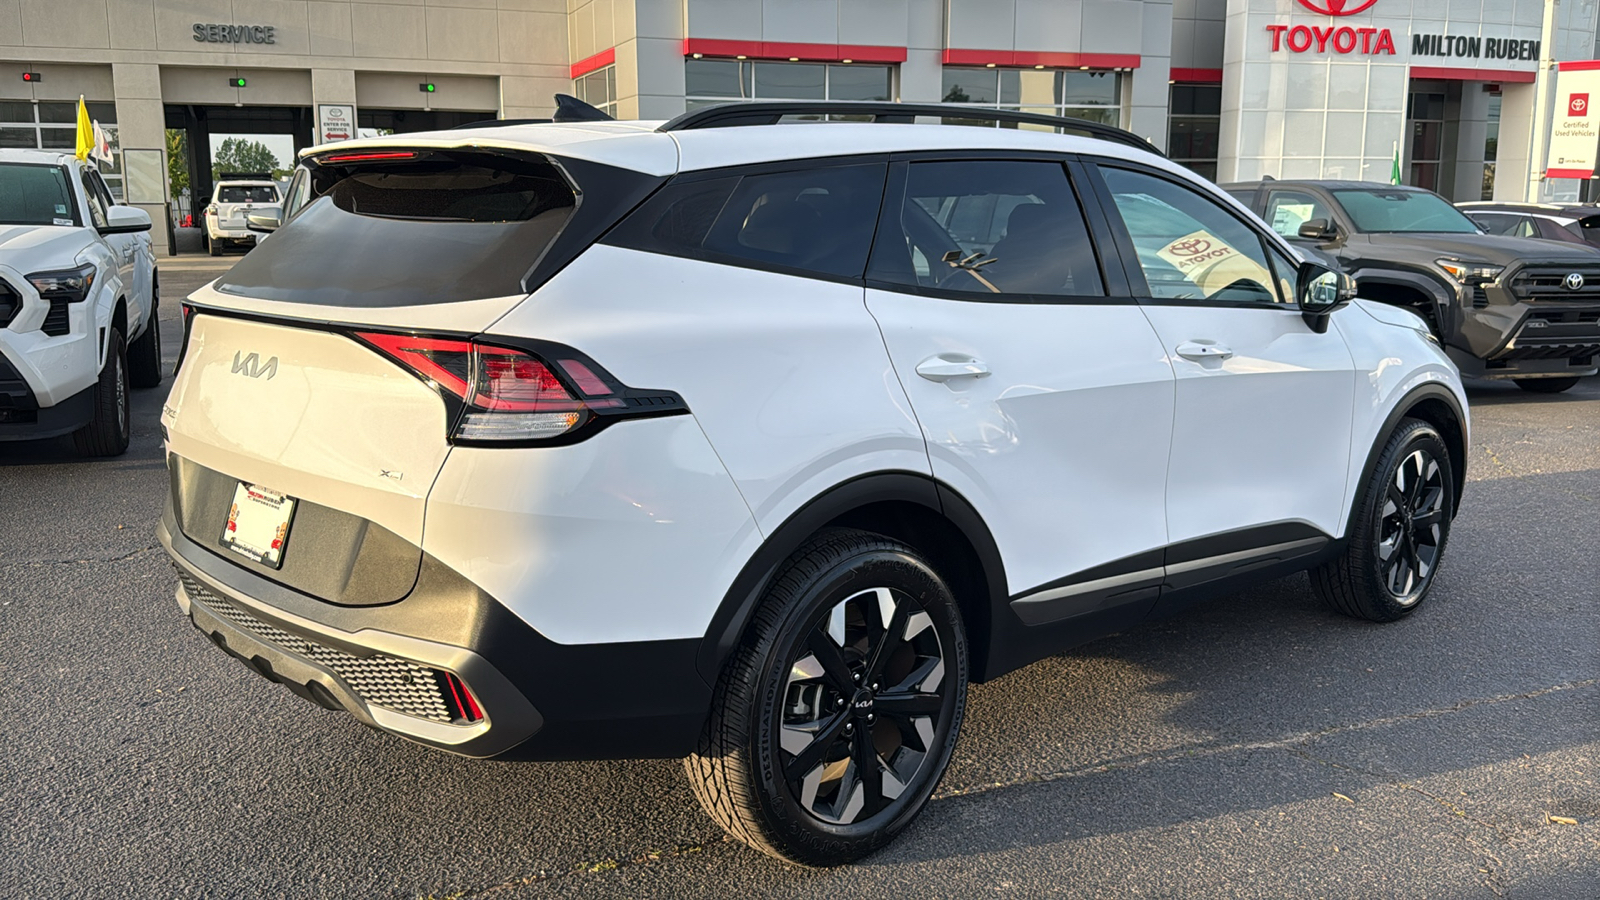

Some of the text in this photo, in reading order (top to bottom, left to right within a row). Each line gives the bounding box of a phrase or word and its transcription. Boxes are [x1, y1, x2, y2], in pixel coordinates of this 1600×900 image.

[192, 23, 275, 44] SERVICE
[1266, 24, 1396, 55] TOYOTA
[1411, 34, 1540, 62] MILTON RUBEN
[762, 678, 777, 781] DESTINATION
